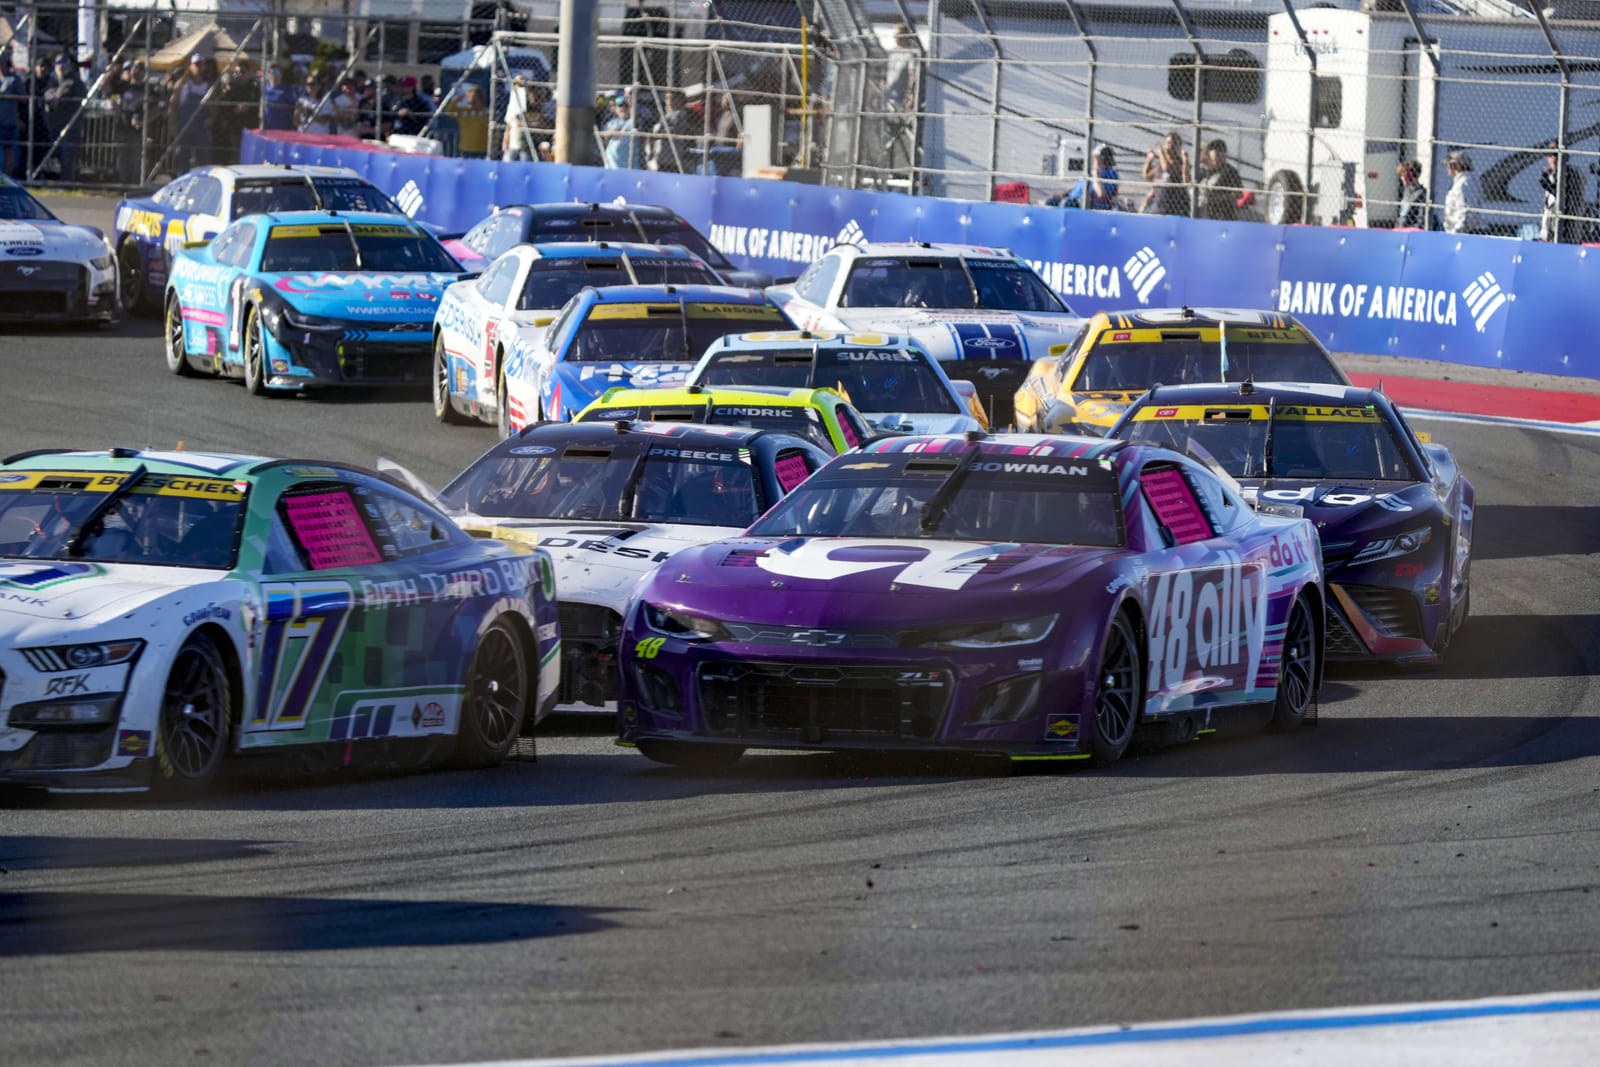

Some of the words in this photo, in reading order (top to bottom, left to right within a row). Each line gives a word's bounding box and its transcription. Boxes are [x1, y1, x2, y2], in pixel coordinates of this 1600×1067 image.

[748, 227, 769, 259] OF
[702, 305, 765, 315] LARSON
[1278, 280, 1336, 316] BANK
[1338, 283, 1368, 318] OF
[1367, 285, 1457, 327] AMERICA
[1247, 330, 1296, 341] BELL
[714, 407, 793, 418] CINDRIC
[1264, 406, 1378, 418] WALLACE
[649, 448, 733, 461] PREECE
[1269, 535, 1293, 568] do
[1293, 531, 1309, 563] it
[1147, 571, 1194, 693] 48
[1195, 549, 1268, 694] ally
[246, 587, 351, 724] 17
[635, 637, 667, 659] 48
[44, 673, 91, 696] RFK
